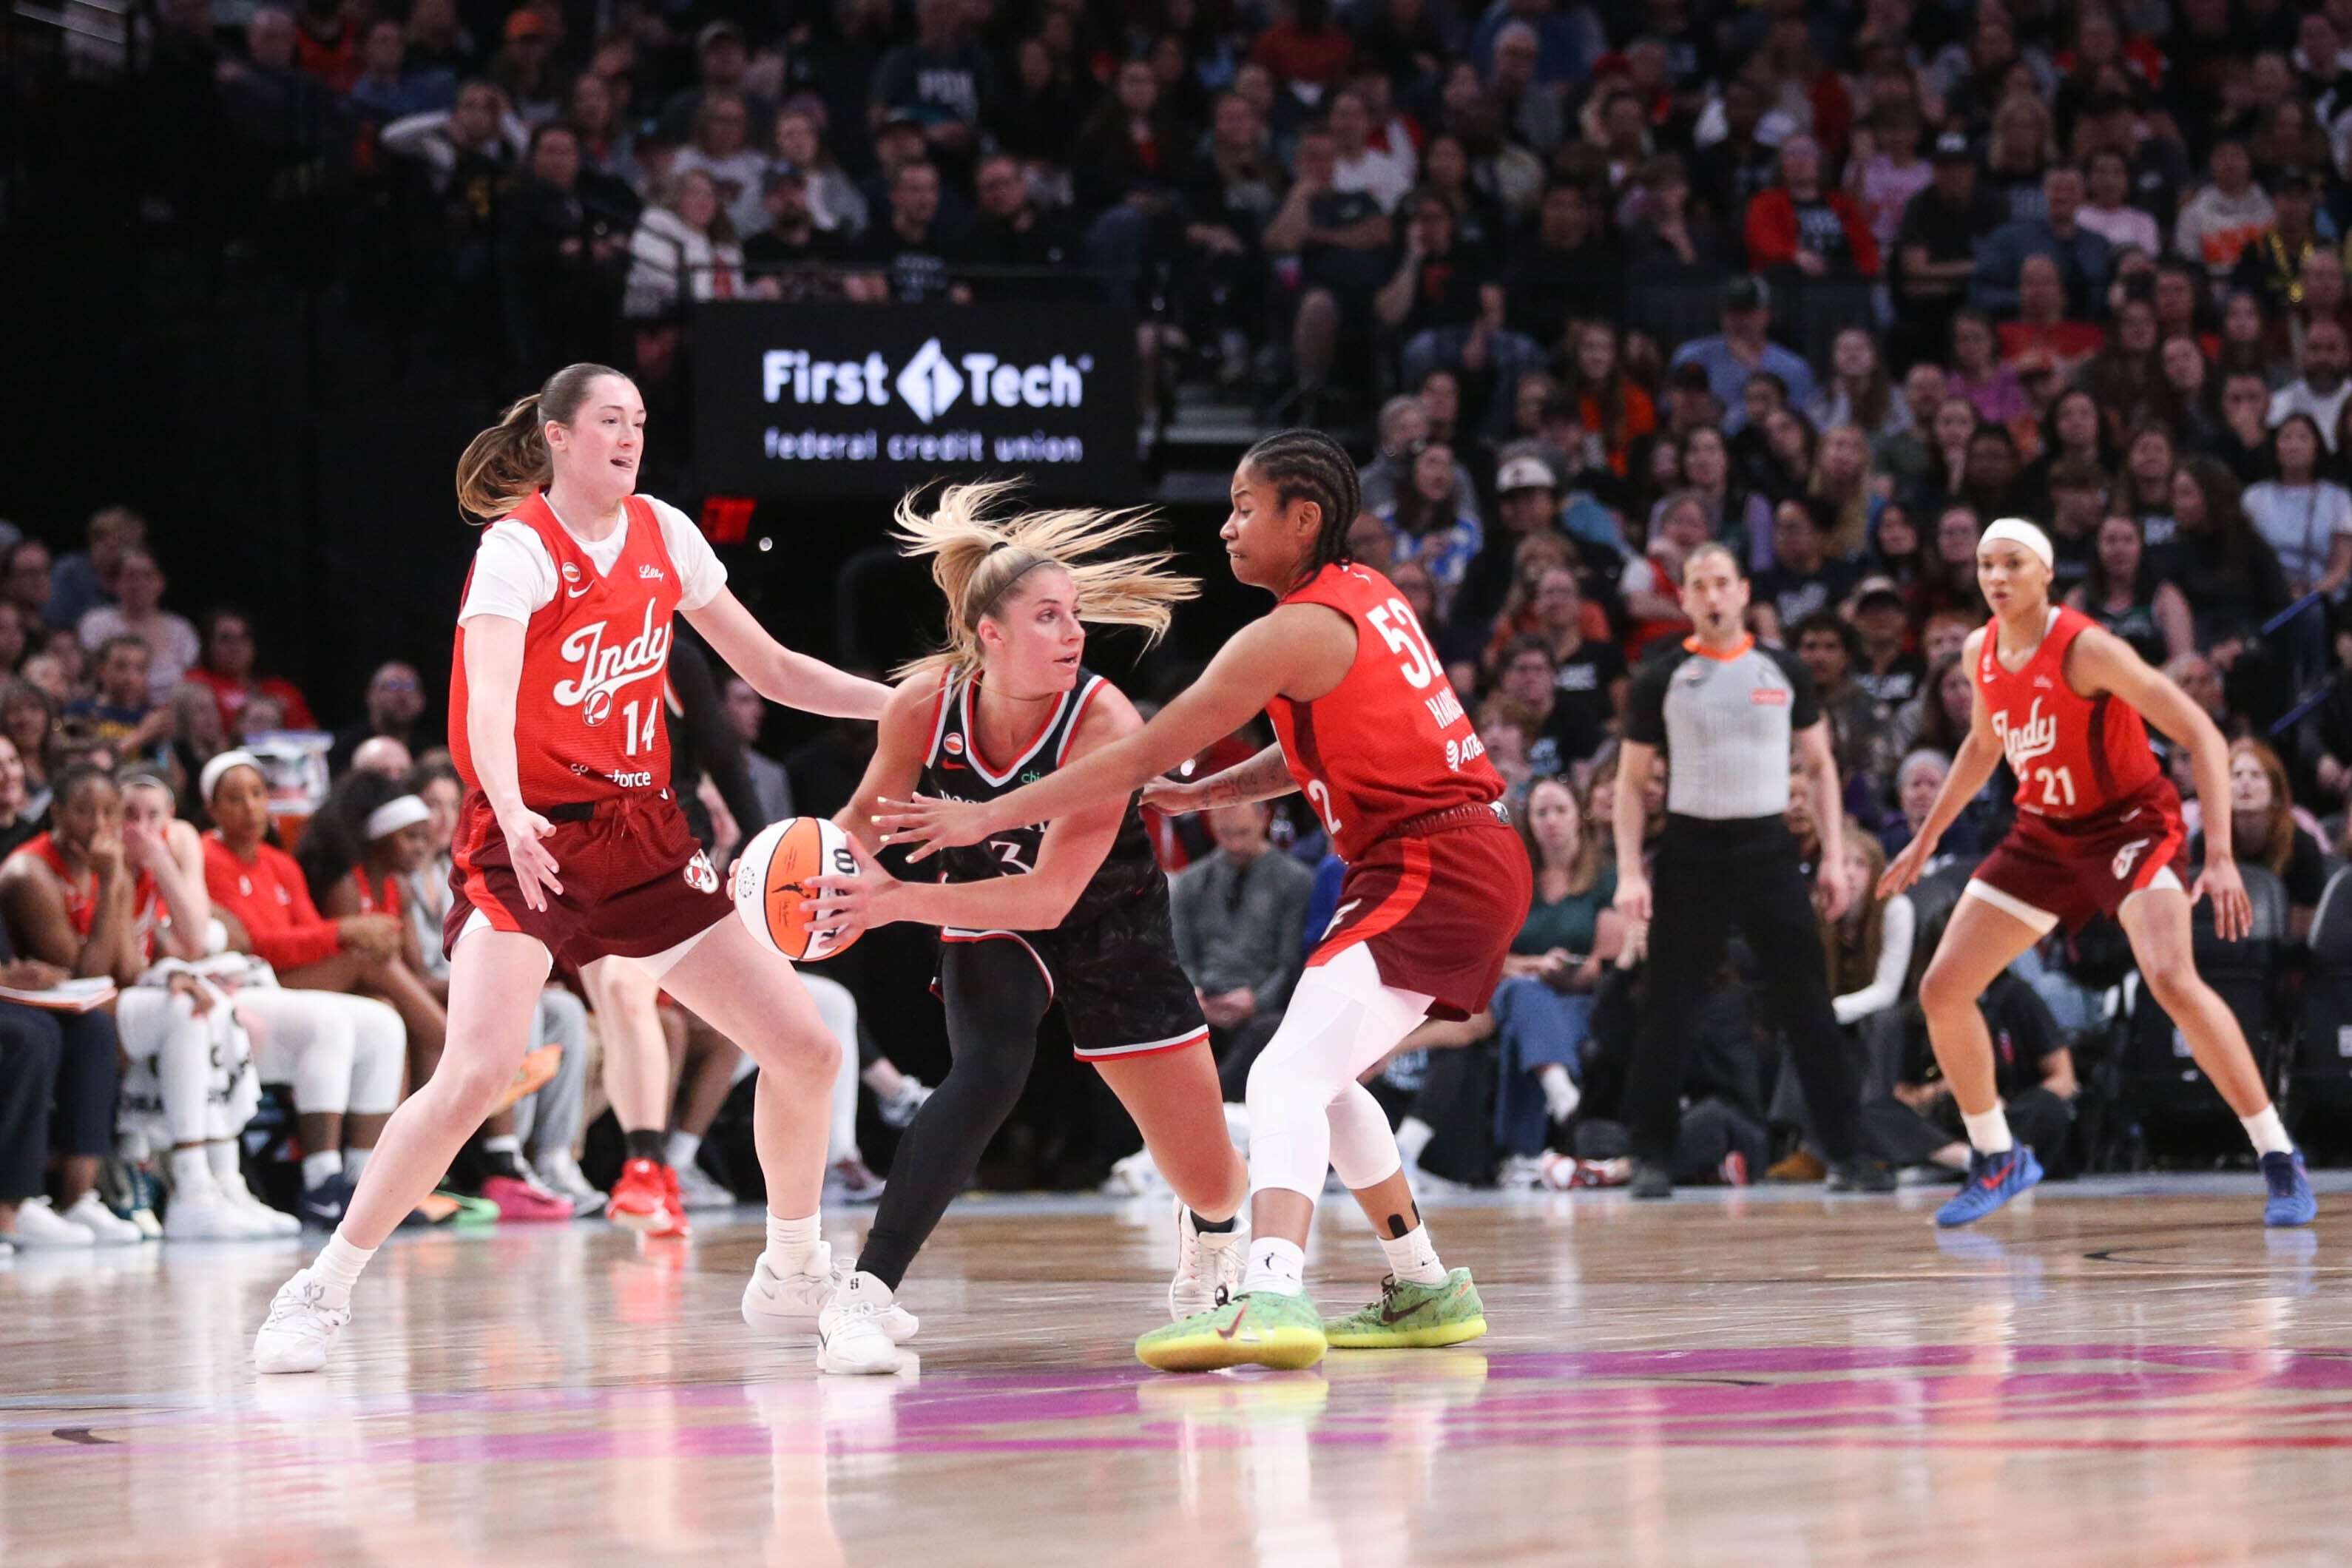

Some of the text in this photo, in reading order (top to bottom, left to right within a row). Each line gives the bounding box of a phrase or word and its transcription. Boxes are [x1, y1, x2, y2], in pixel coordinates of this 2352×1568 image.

[763, 349, 1083, 408] First Tech
[764, 427, 1084, 463] federal credit union
[553, 596, 671, 707] Indy
[1366, 598, 1444, 690] 52
[623, 697, 658, 757] 14
[1460, 732, 1485, 764] AT&
[1991, 695, 2058, 772] Indy
[1021, 771, 1040, 784] chi
[2035, 766, 2076, 807] 21
[1308, 780, 1342, 835] 2
